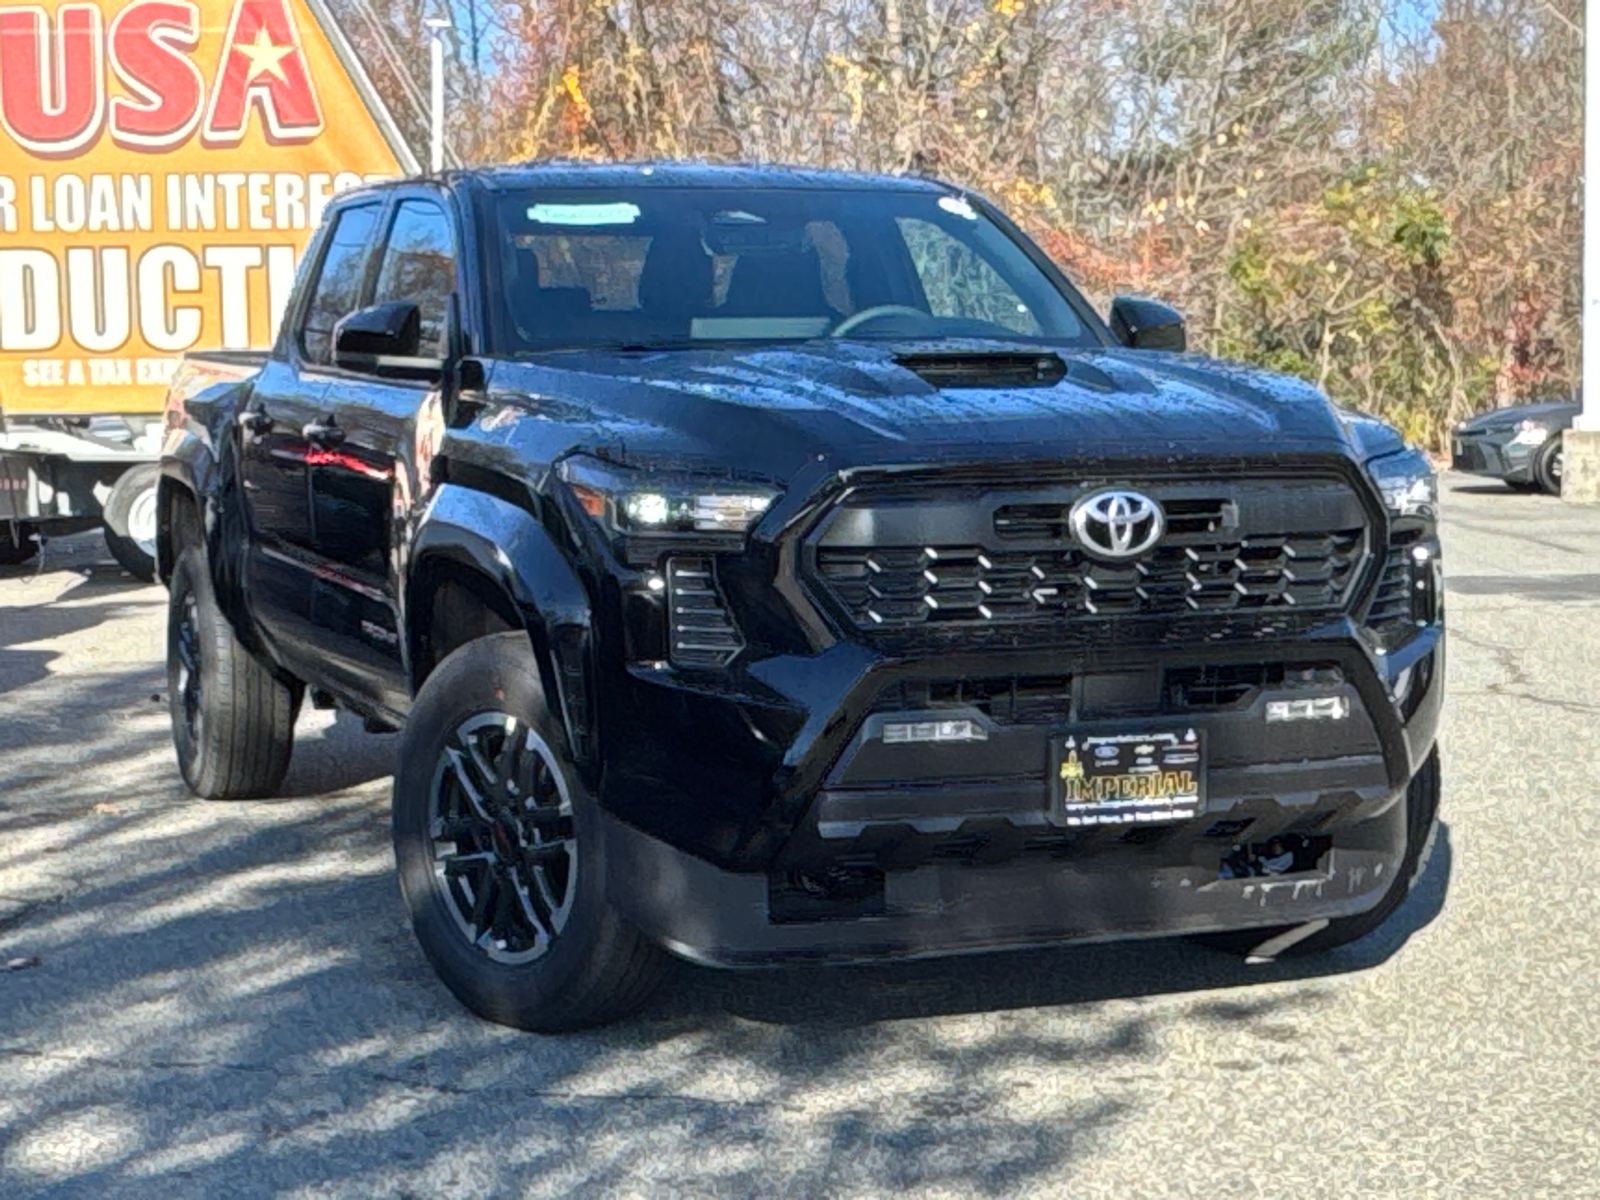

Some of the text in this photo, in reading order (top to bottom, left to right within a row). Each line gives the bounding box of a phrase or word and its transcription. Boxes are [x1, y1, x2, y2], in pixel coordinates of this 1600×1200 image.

[0, 0, 323, 152] USA
[31, 173, 150, 232] LOAN
[24, 359, 64, 387] SEE
[68, 359, 86, 386] A
[88, 359, 132, 386] TAX
[1066, 771, 1197, 803] IMPERIAL
